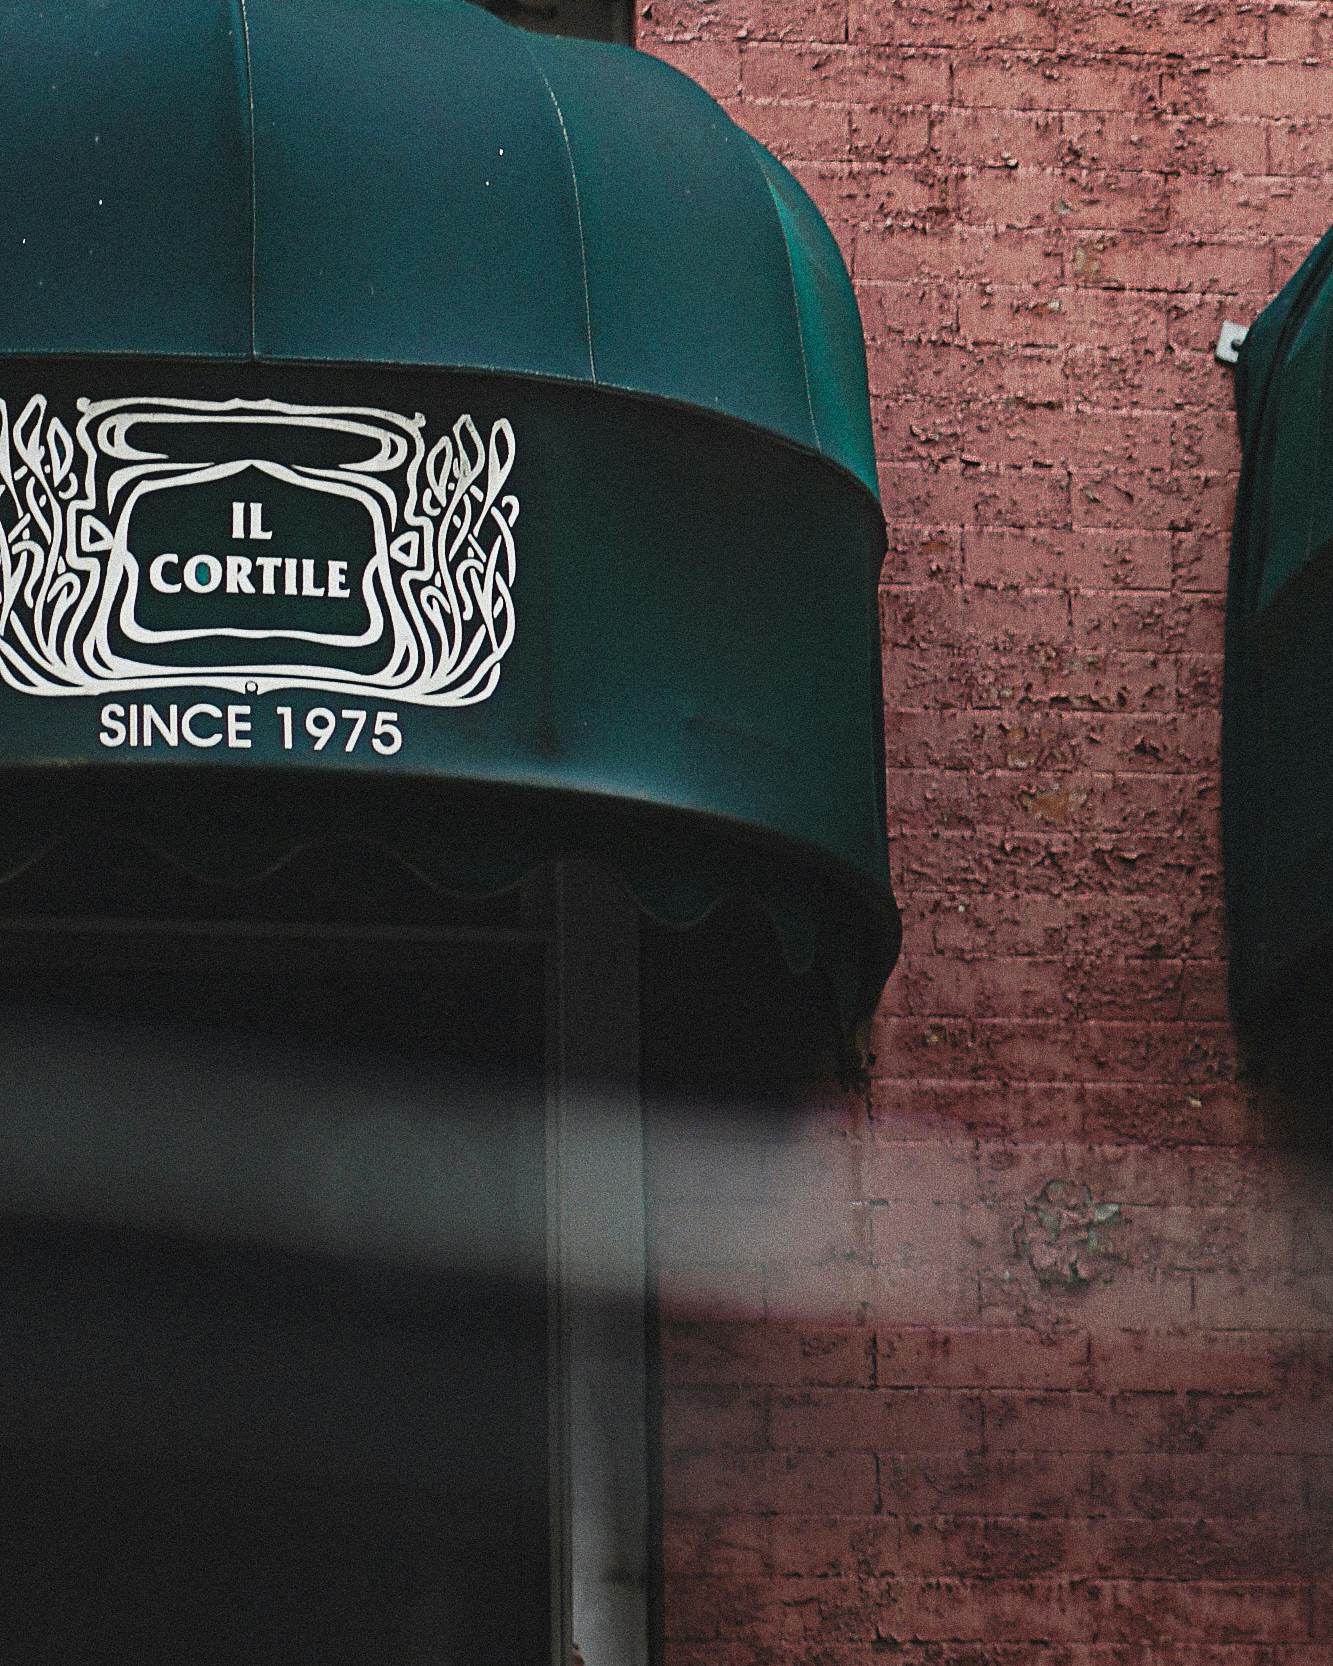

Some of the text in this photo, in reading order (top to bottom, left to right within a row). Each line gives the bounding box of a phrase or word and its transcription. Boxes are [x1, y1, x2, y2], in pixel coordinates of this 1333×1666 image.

[231, 501, 273, 540] IL
[149, 553, 351, 598] CORTILE
[99, 703, 402, 756] SINCE 1975
